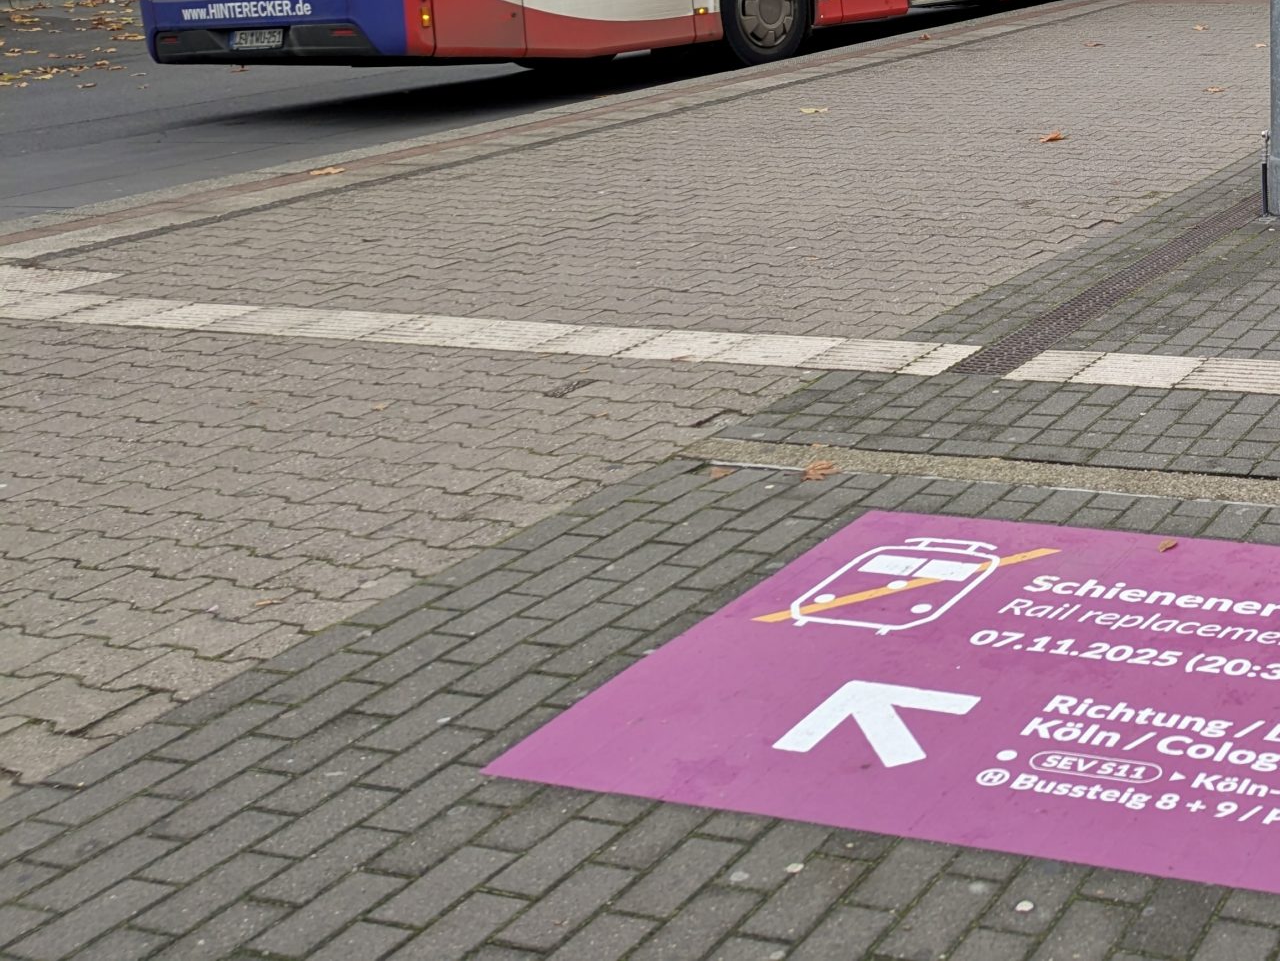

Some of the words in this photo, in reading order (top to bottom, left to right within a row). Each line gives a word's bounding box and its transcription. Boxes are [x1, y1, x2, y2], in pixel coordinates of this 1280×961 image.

[182, 0, 312, 20] www.HINTERECKER.de
[998, 598, 1081, 622] Rail
[969, 629, 1183, 667] 07.11.2025
[1043, 694, 1234, 738] Richtung
[1233, 720, 1266, 738] /
[1020, 717, 1121, 747] Köln
[1122, 732, 1157, 751] /
[1041, 754, 1098, 773] SEV
[1096, 761, 1146, 780] S11
[1010, 773, 1152, 810] Bussteig
[1155, 793, 1180, 810] 8
[1186, 800, 1206, 812] +
[1213, 801, 1238, 818] 9
[1237, 805, 1263, 822] /
